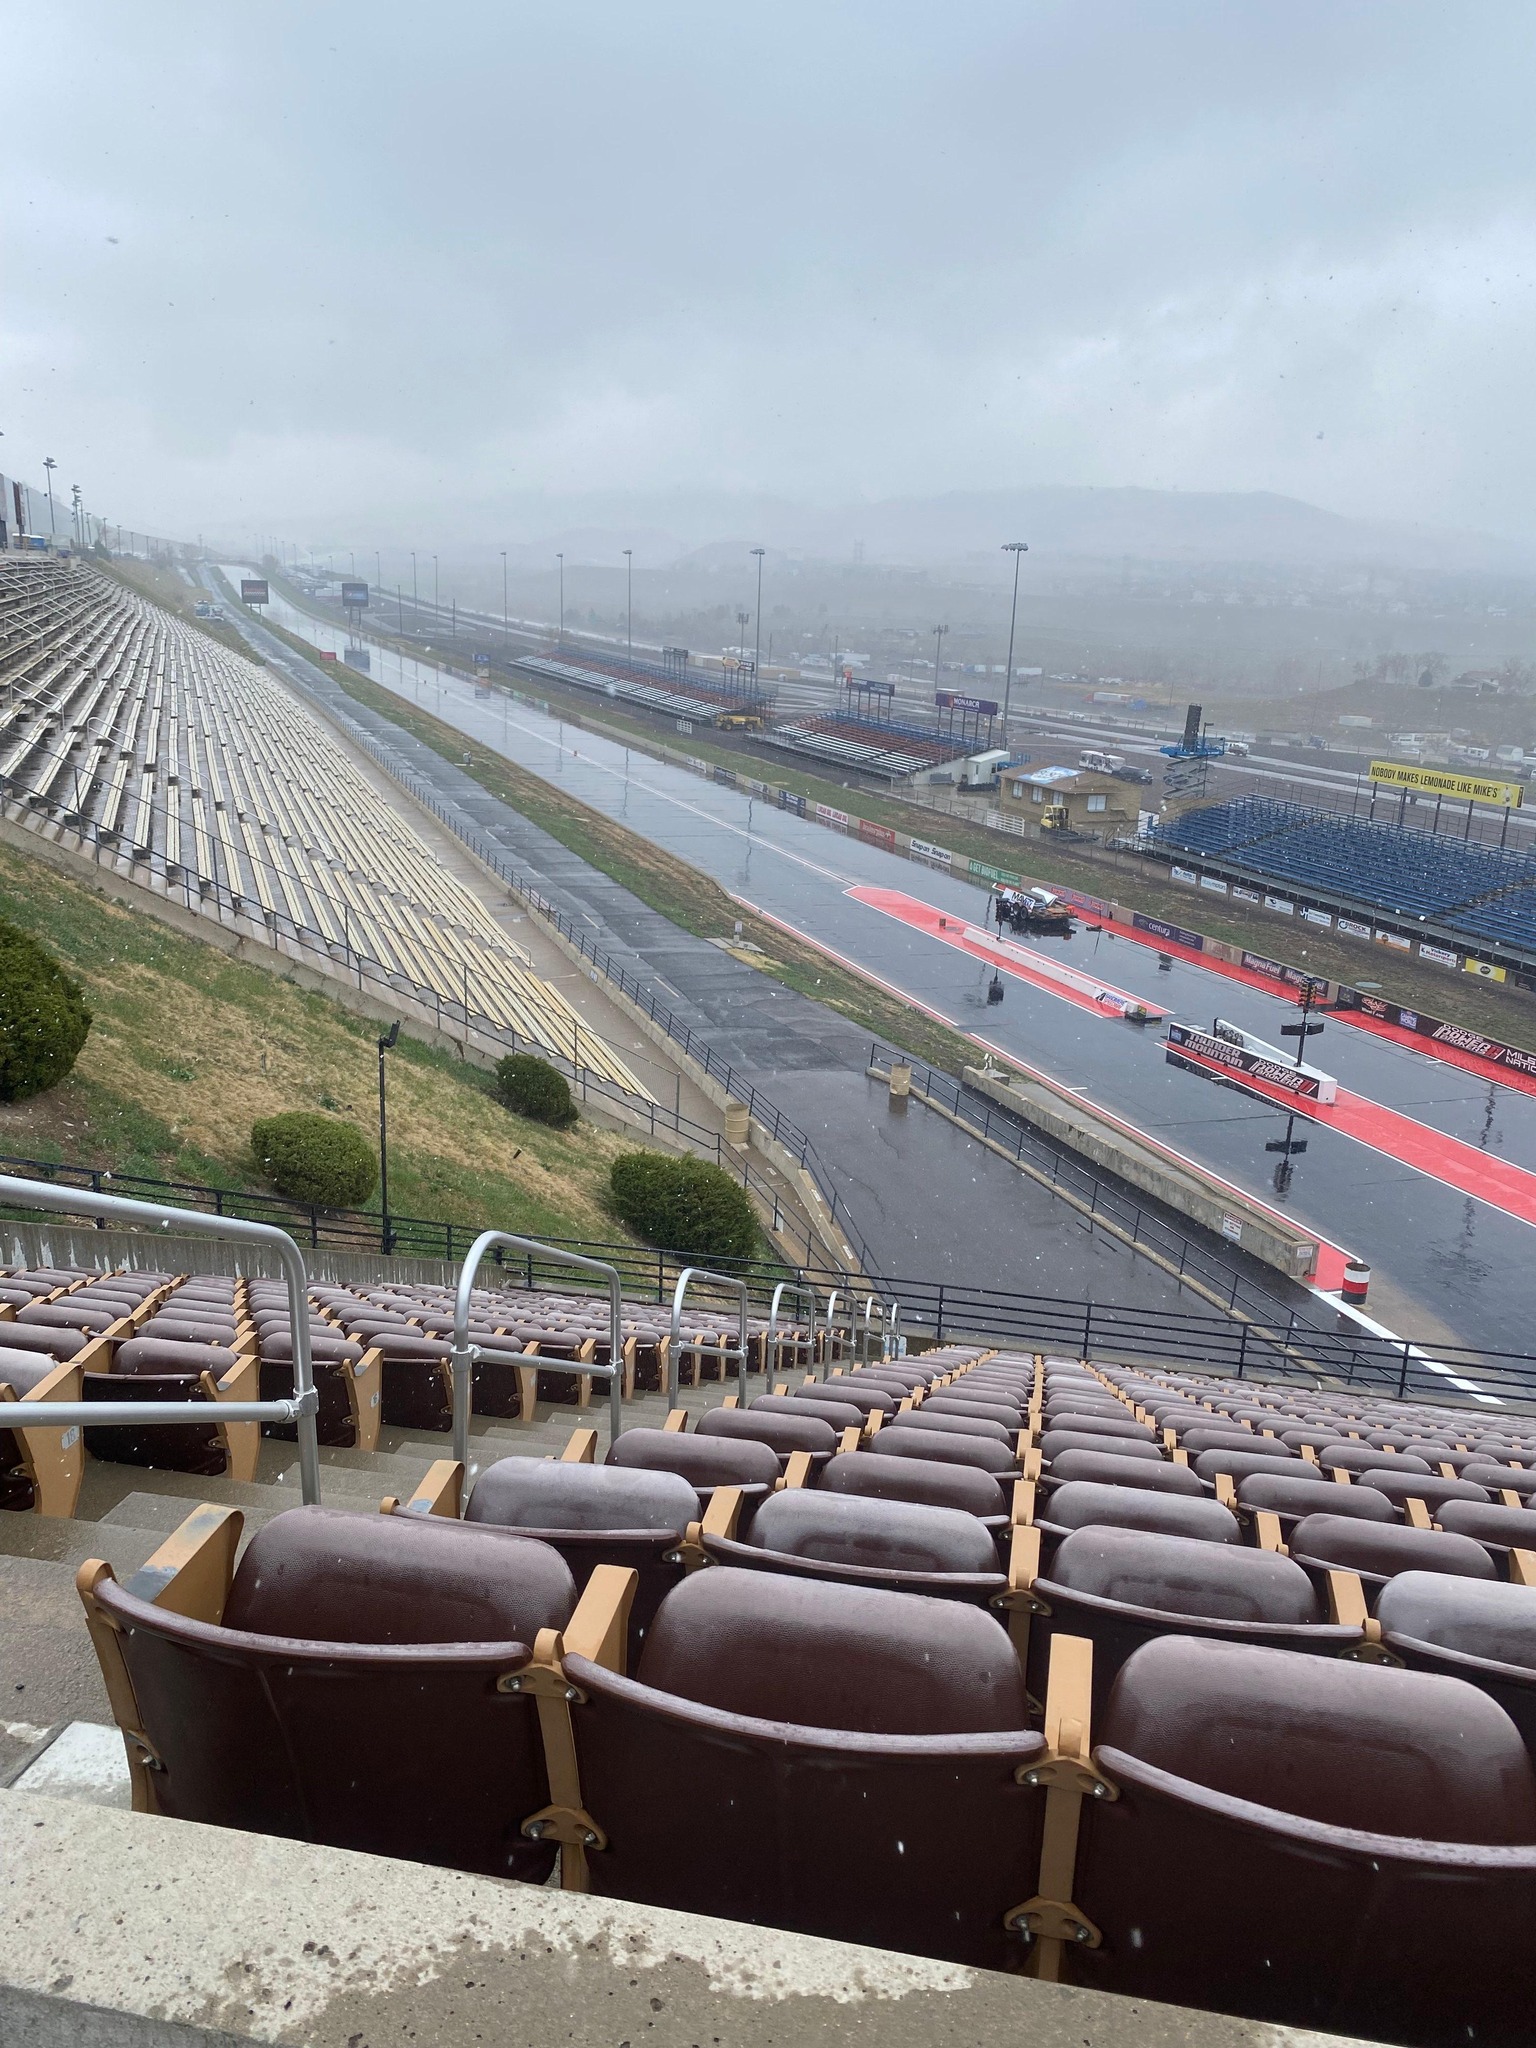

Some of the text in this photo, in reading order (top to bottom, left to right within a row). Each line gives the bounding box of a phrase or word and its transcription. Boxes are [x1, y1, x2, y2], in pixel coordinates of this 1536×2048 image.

[1371, 766, 1498, 798] NOBODY MAKES LEMONADE LIKE MIKE'S
[1189, 1032, 1241, 1058] THUNDER
[1437, 1028, 1491, 1052] POWER
[1184, 1039, 1243, 1068] MOUNTAIN
[1253, 1062, 1303, 1086] POWER
